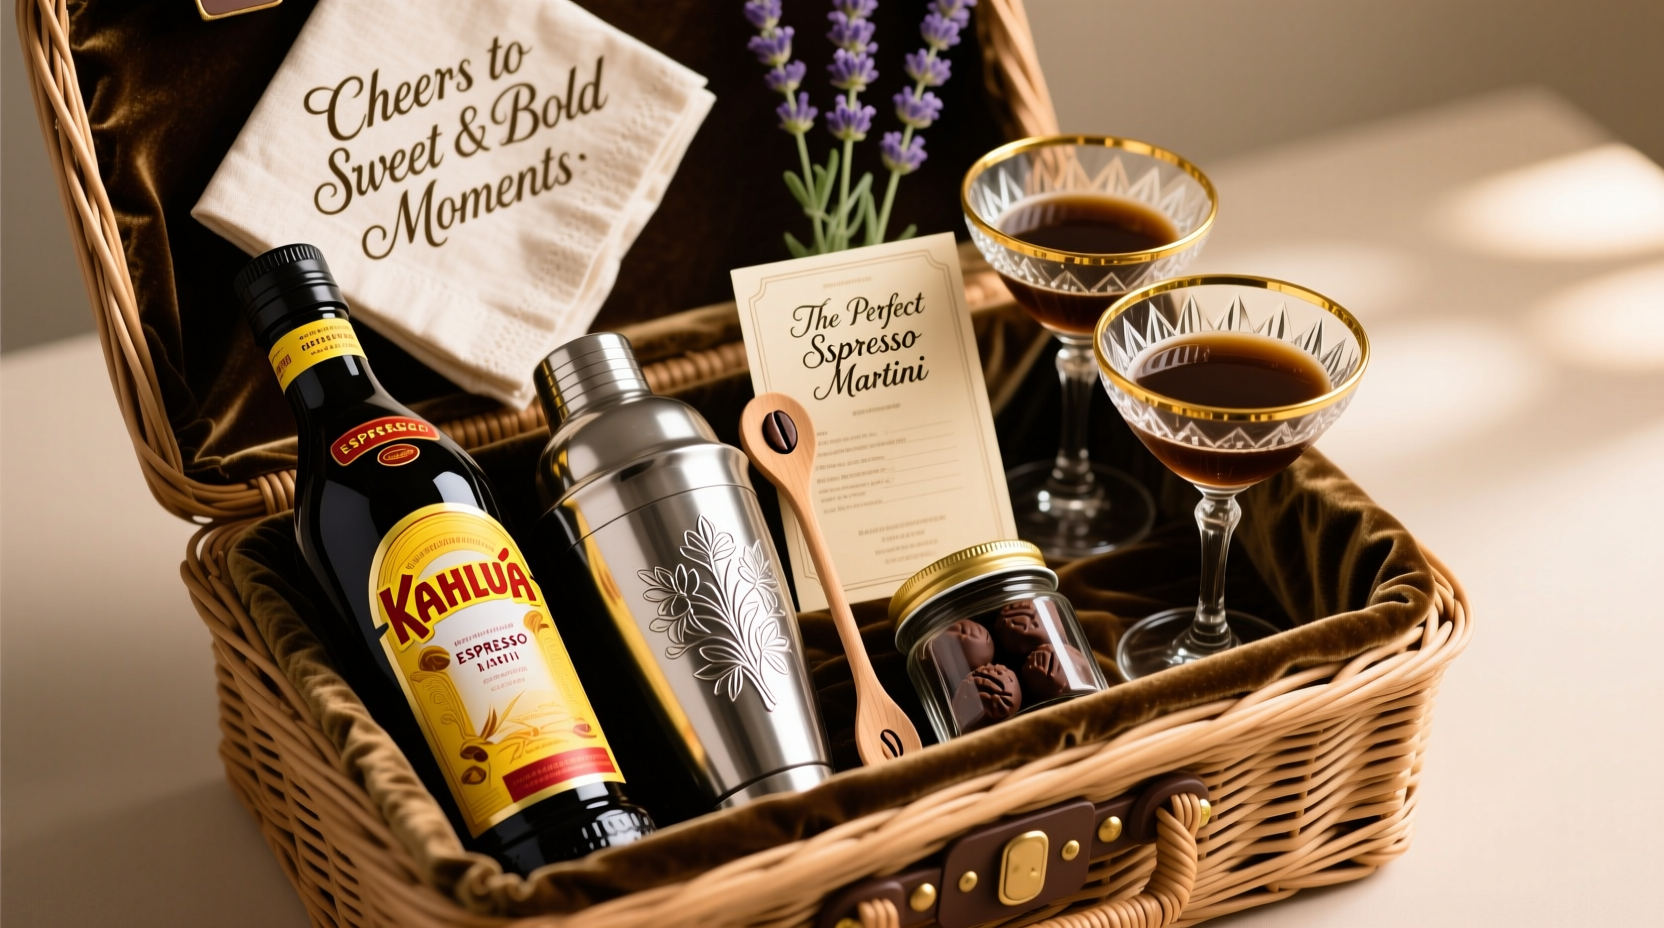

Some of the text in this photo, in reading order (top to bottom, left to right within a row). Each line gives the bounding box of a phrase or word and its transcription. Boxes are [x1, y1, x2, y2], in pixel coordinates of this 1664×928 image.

[303, 36, 532, 141] Cheers to
[314, 55, 607, 214] Sweet & Bold
[790, 292, 925, 338] The Perfect
[813, 356, 929, 400] Martini
[379, 548, 536, 645] KAHLÚA
[456, 633, 527, 665] ESPRESSO
